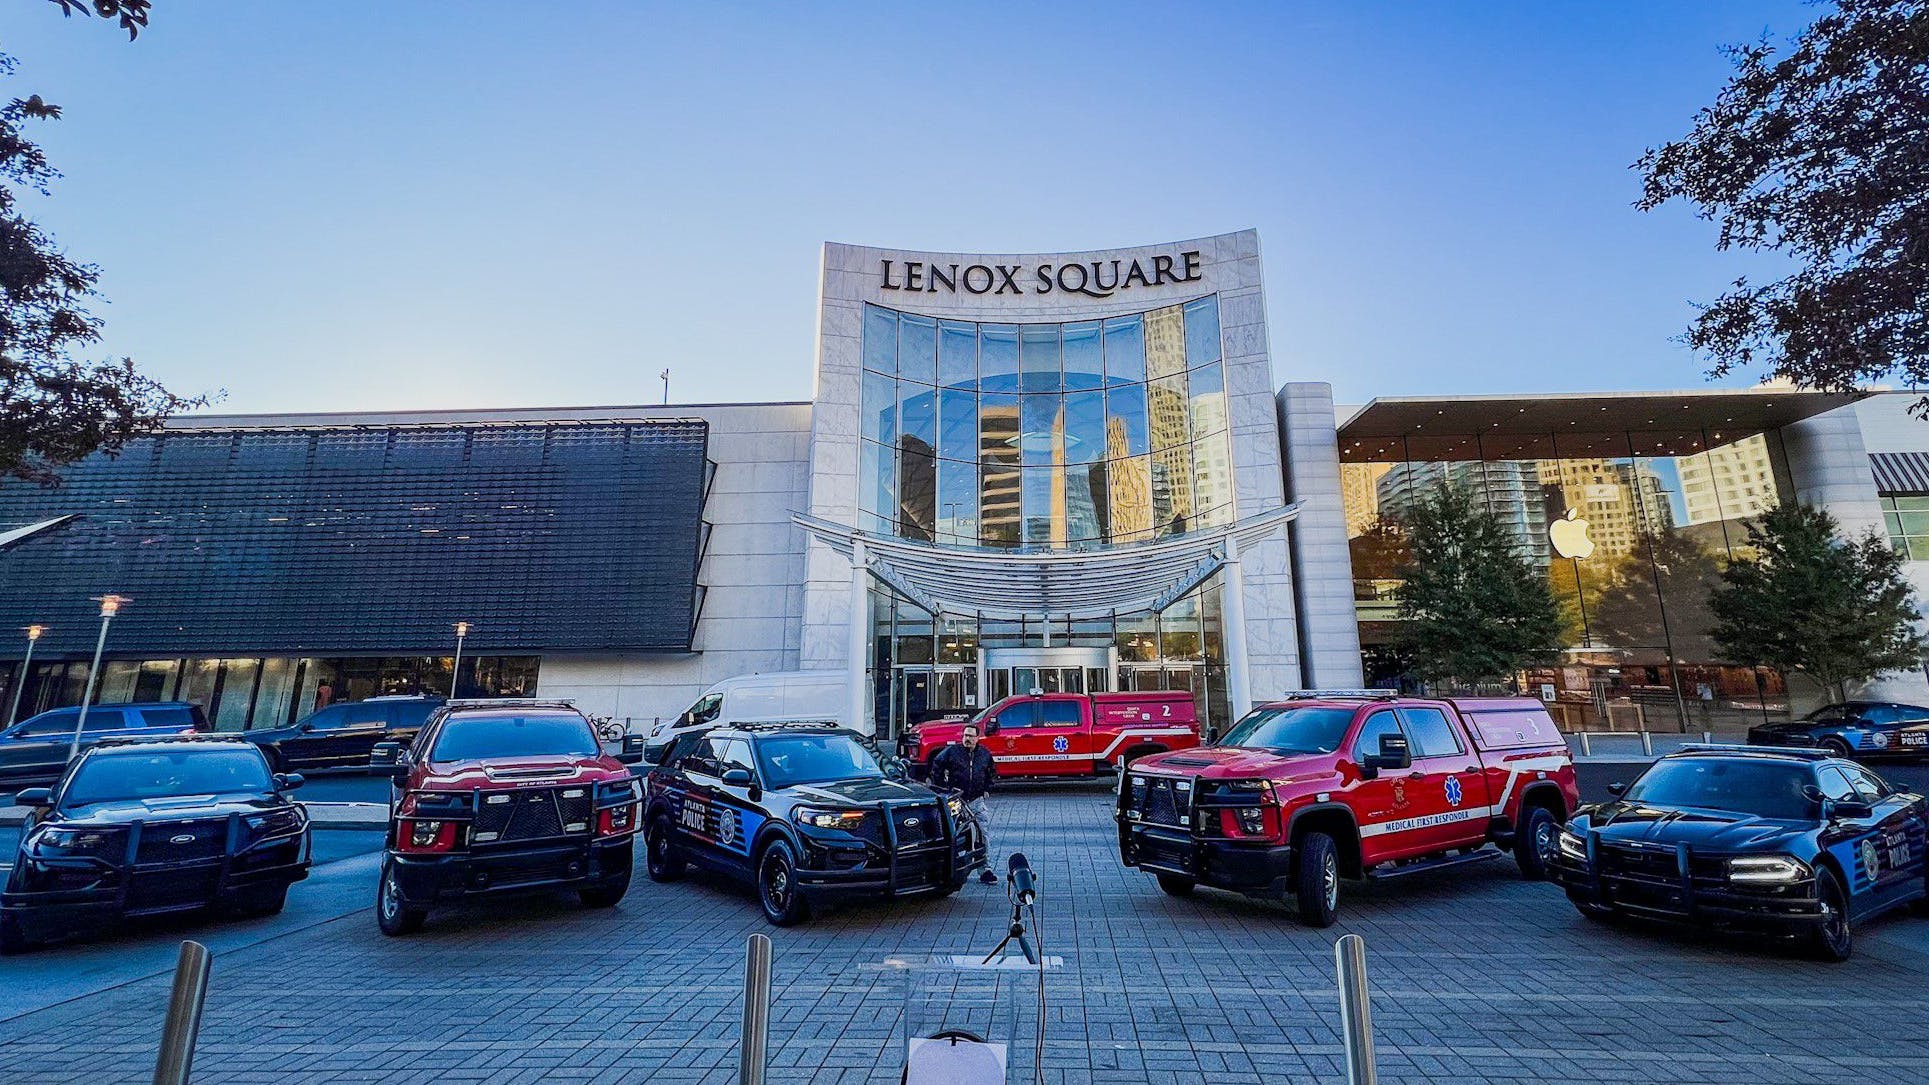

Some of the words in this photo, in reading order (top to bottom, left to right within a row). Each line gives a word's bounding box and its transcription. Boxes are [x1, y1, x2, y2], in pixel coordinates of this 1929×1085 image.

[880, 258, 1024, 296] LENOX
[1035, 250, 1203, 299] SQUARE
[1162, 704, 1172, 717] 2
[1901, 736, 1929, 745] POLICE
[683, 799, 706, 814] ATLANTA
[681, 808, 706, 832] POLICE
[1385, 819, 1416, 832] MEDICAL
[1417, 816, 1433, 827] FIRST
[1434, 810, 1469, 824] RESPONDER
[1886, 831, 1907, 847] ATLANTA
[1888, 843, 1911, 869] POLICE
